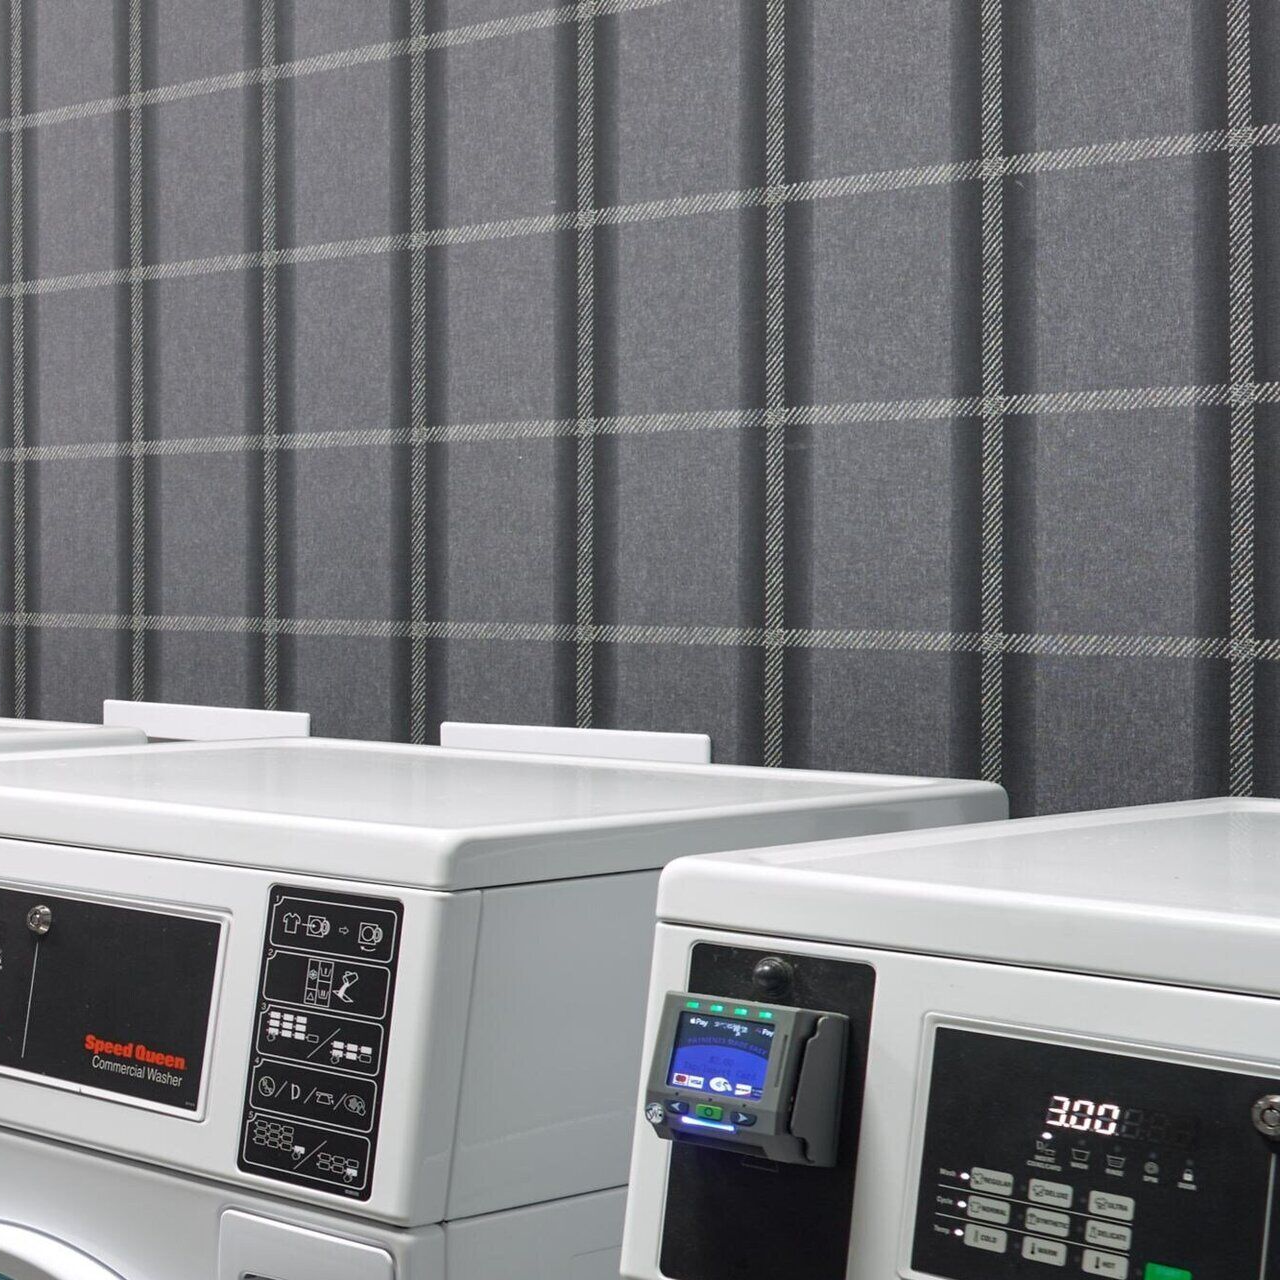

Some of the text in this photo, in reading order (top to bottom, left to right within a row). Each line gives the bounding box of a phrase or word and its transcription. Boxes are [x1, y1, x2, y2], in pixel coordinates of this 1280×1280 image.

[85, 1034, 186, 1070] Speed Queen
[92, 1055, 183, 1087] Commercial Washer
[1046, 1095, 1120, 1135] 3.00
